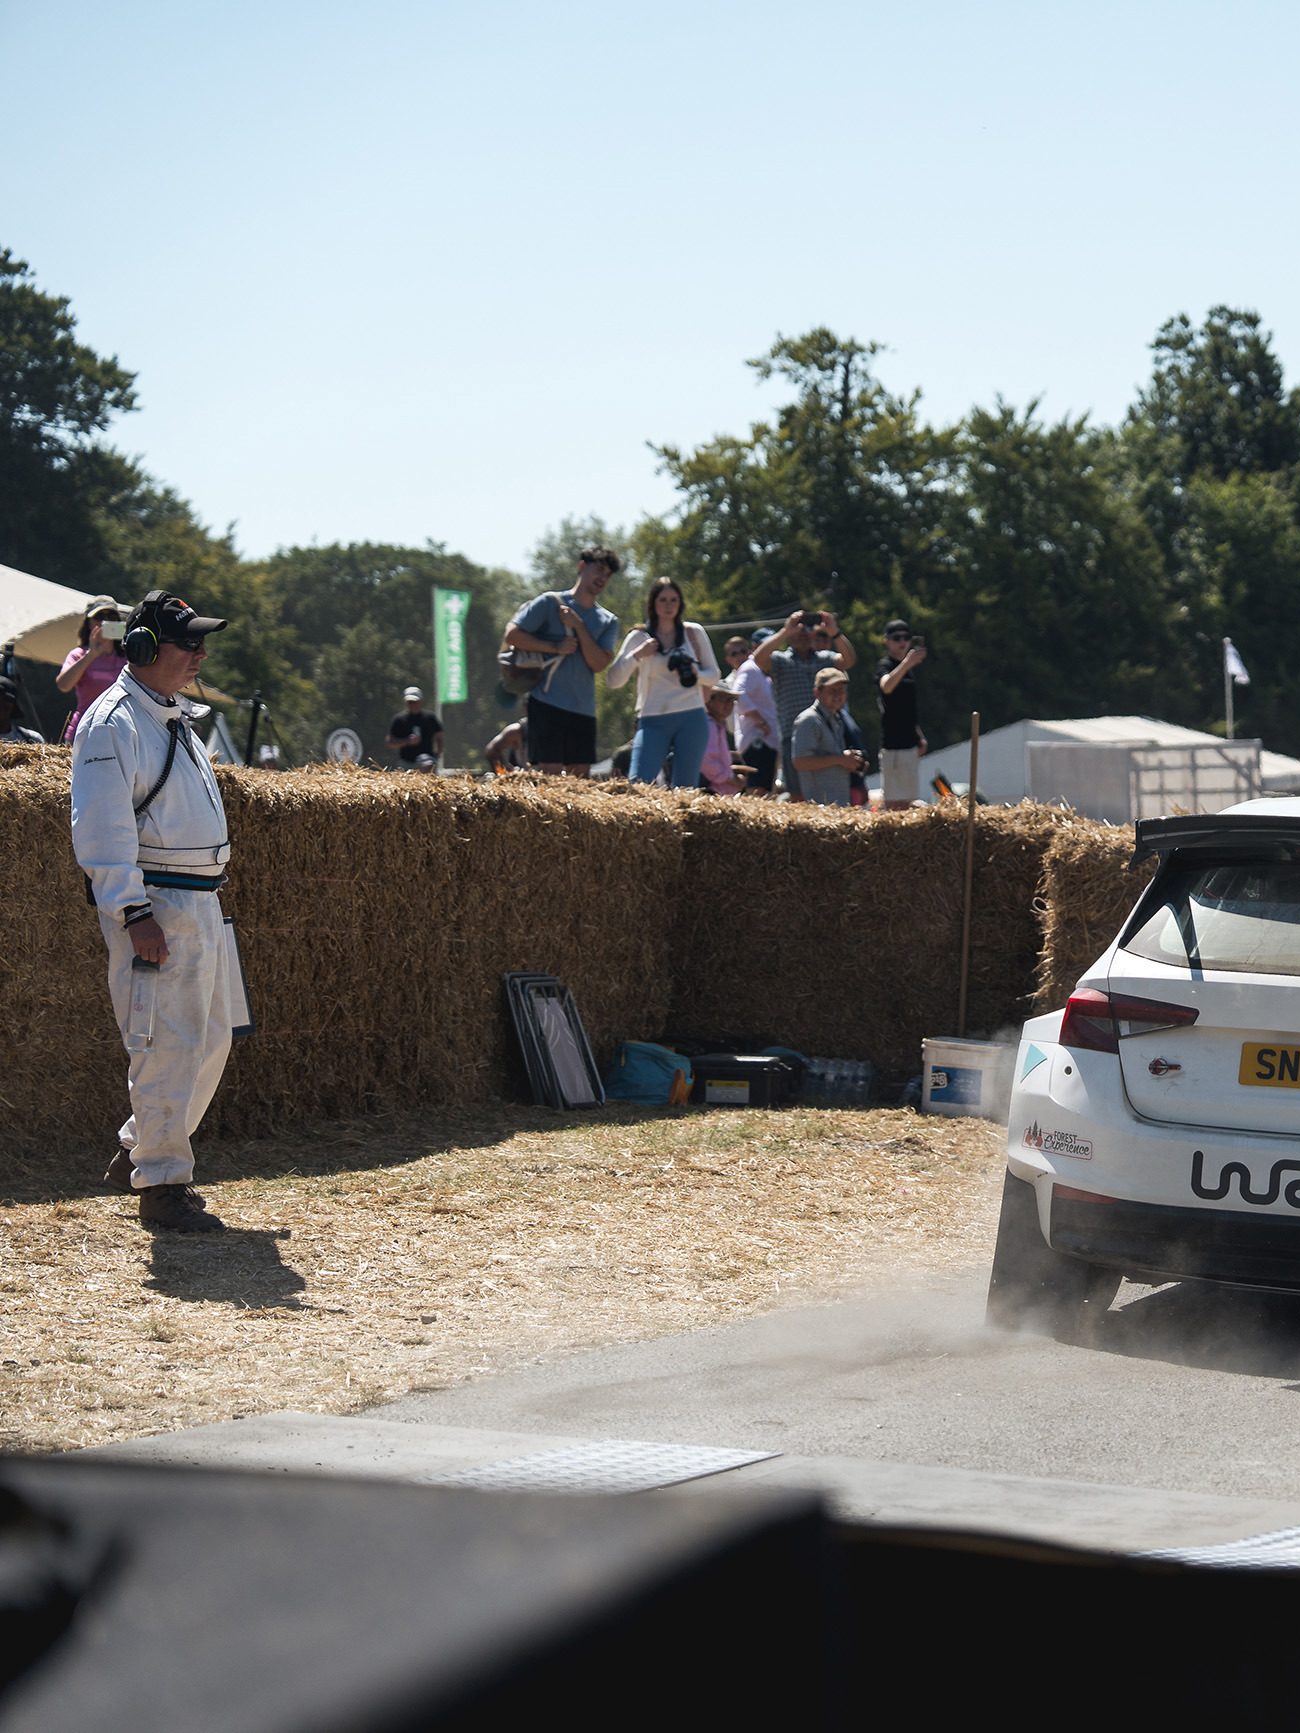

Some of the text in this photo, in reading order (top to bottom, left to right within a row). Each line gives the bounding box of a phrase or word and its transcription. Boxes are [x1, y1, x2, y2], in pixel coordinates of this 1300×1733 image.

[447, 620, 462, 700] FIRST AID
[1044, 1134, 1090, 1156] Experience
[1054, 1130, 1078, 1145] FOREST
